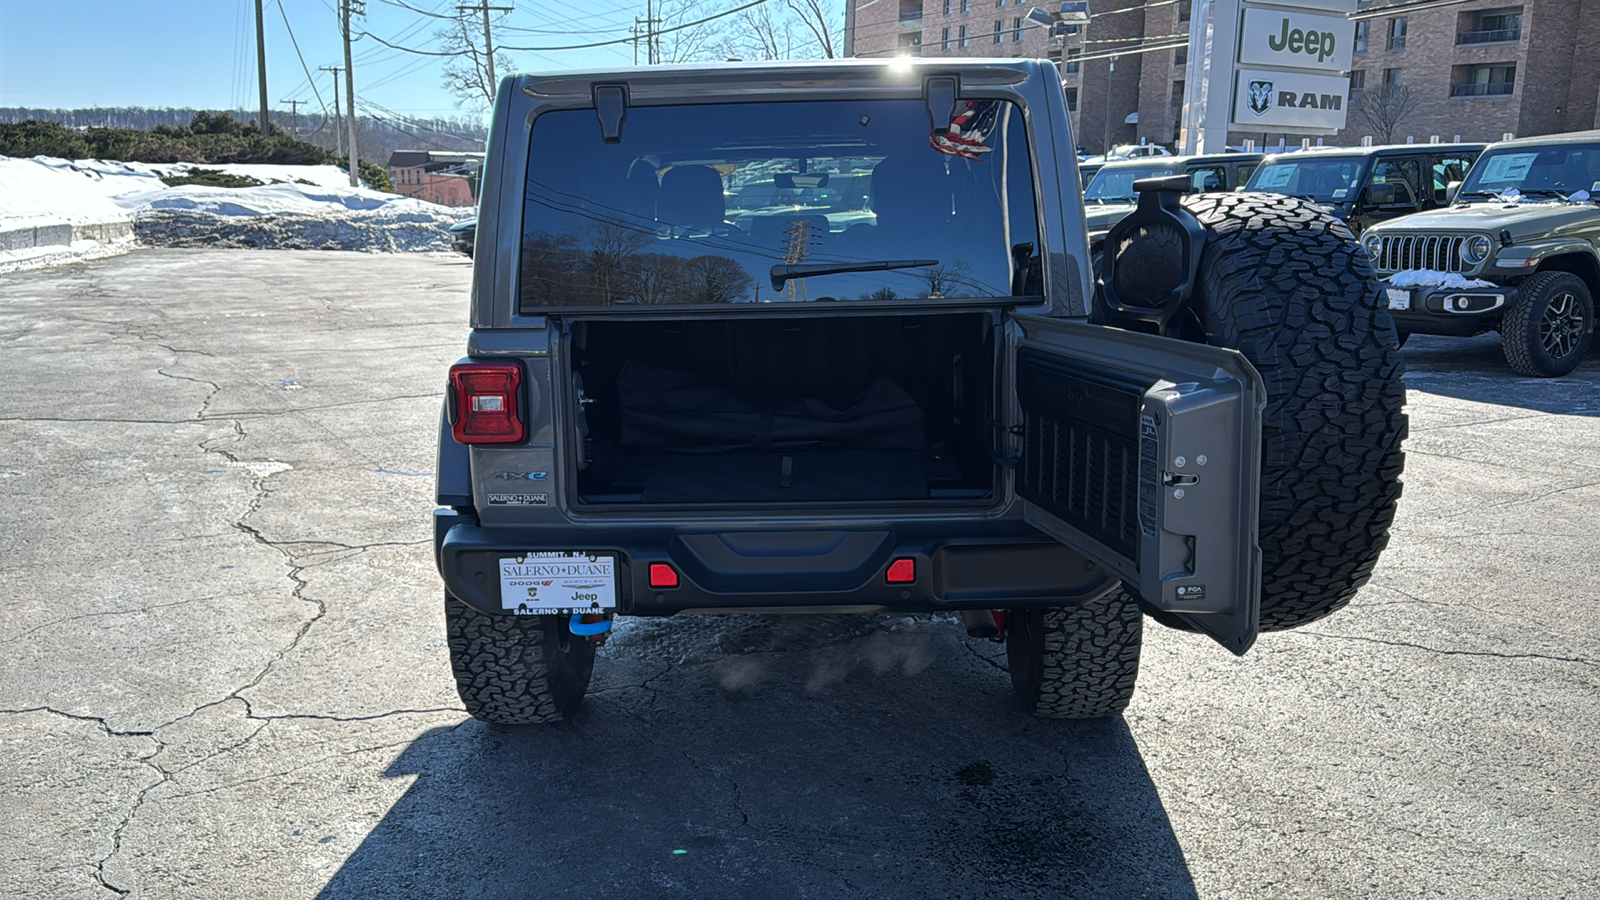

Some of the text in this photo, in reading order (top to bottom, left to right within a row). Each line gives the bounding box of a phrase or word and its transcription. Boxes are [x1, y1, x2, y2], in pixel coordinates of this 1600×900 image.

[1268, 18, 1336, 63] Jeep
[1277, 91, 1342, 111] RAM
[503, 565, 611, 576] SALERNO DUANE
[571, 592, 598, 602] Jeep
[513, 607, 604, 616] SALERNO DUANE
